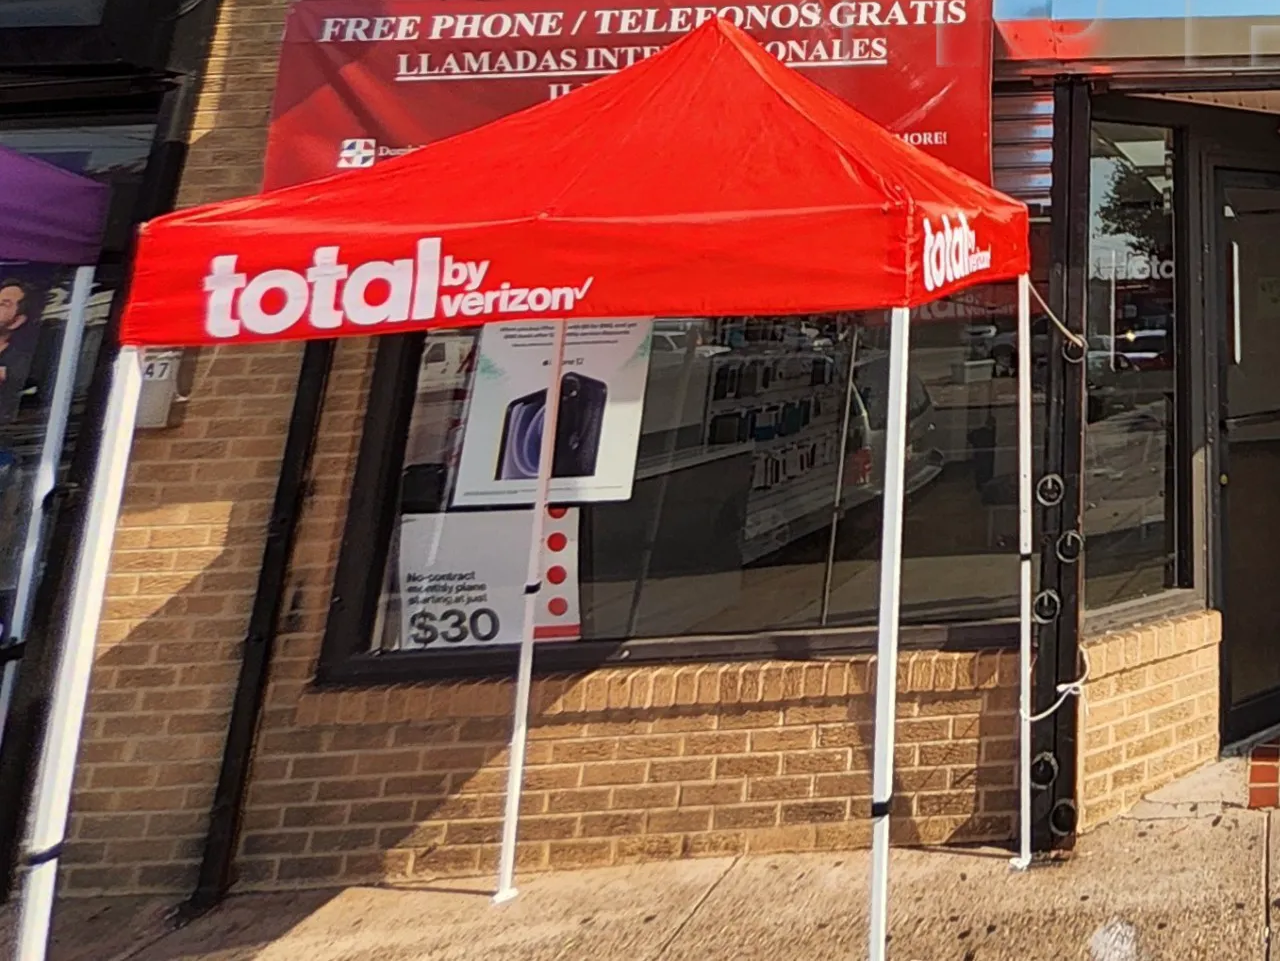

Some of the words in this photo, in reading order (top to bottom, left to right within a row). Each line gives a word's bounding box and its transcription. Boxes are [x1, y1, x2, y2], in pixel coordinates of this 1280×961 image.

[318, 15, 421, 43] FREE
[428, 11, 564, 40] PHONE
[571, 10, 588, 37] /
[594, 3, 822, 35] TELEFONOS
[396, 47, 578, 76] LLAMADAS
[204, 237, 443, 338] total
[443, 255, 490, 290] by
[441, 280, 576, 318] verizon
[410, 607, 500, 649] $30
